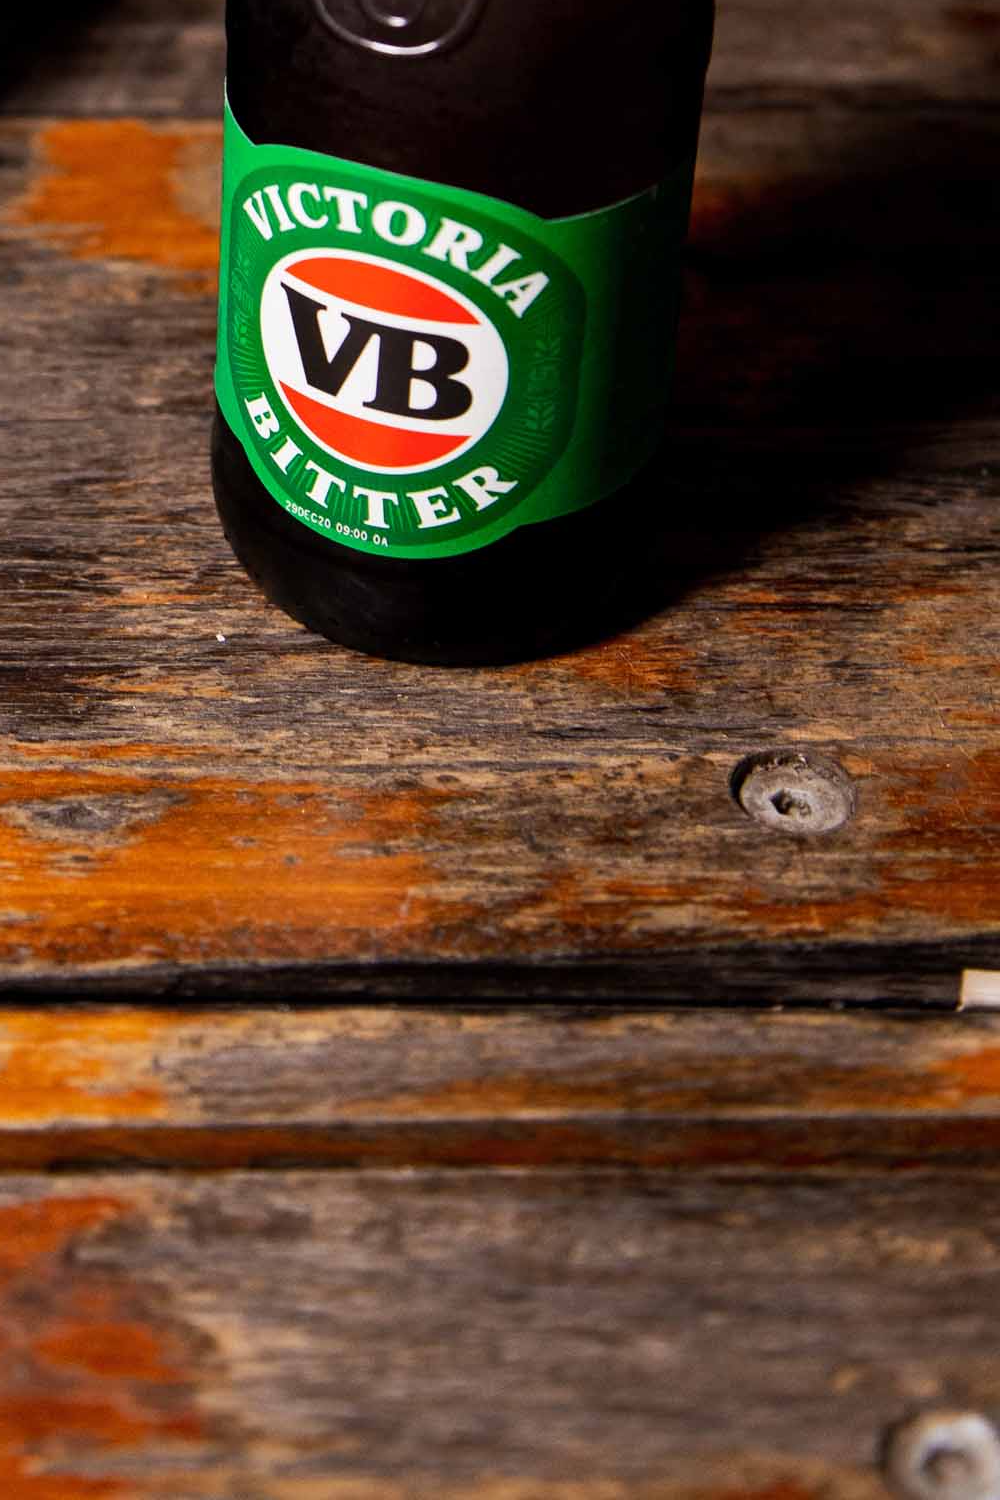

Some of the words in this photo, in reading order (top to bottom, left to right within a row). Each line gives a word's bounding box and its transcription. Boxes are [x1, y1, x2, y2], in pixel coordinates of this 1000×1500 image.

[242, 183, 550, 319] VICTORIA
[280, 281, 474, 422] VB
[244, 391, 519, 530] BITTER
[285, 499, 332, 530] 29DEC20
[335, 522, 369, 542] 09:00
